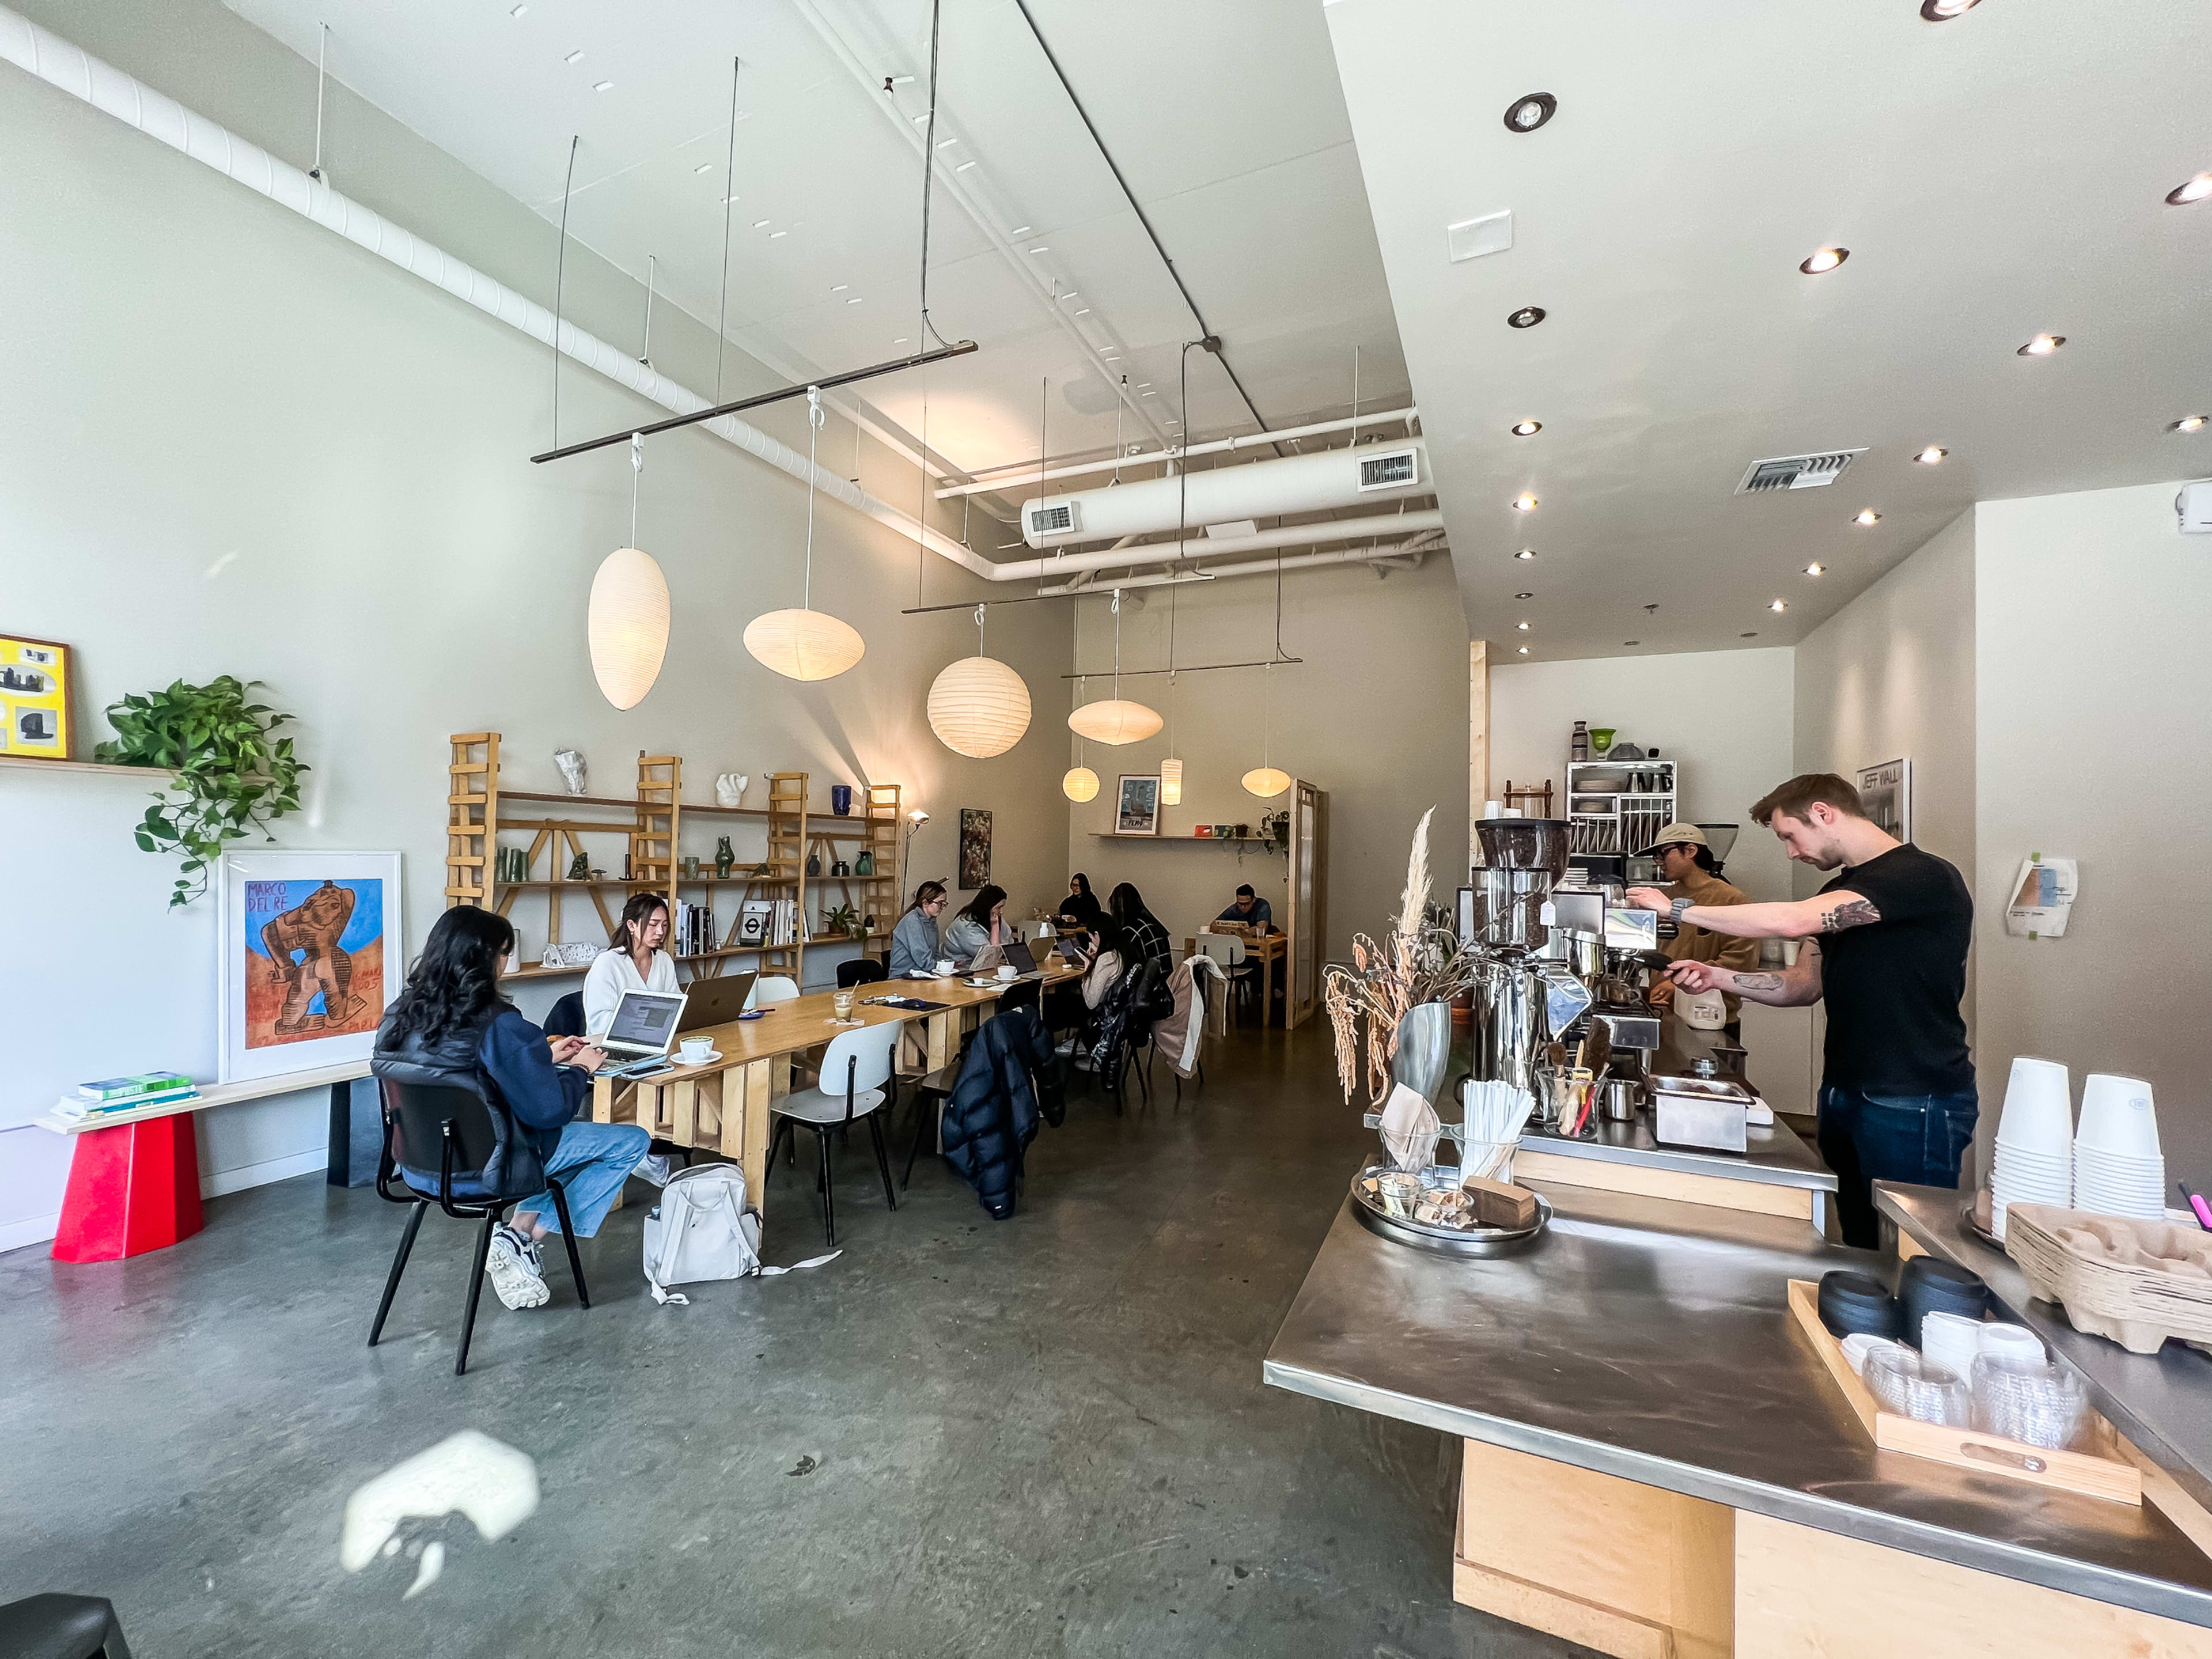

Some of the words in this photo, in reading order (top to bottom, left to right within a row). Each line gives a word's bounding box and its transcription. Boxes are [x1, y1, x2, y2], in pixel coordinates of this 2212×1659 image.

[1879, 767, 1898, 786] WALL
[248, 882, 286, 897] MARCO
[248, 897, 272, 912] DEL
[274, 896, 288, 911] RE
[353, 978, 380, 991] 2005
